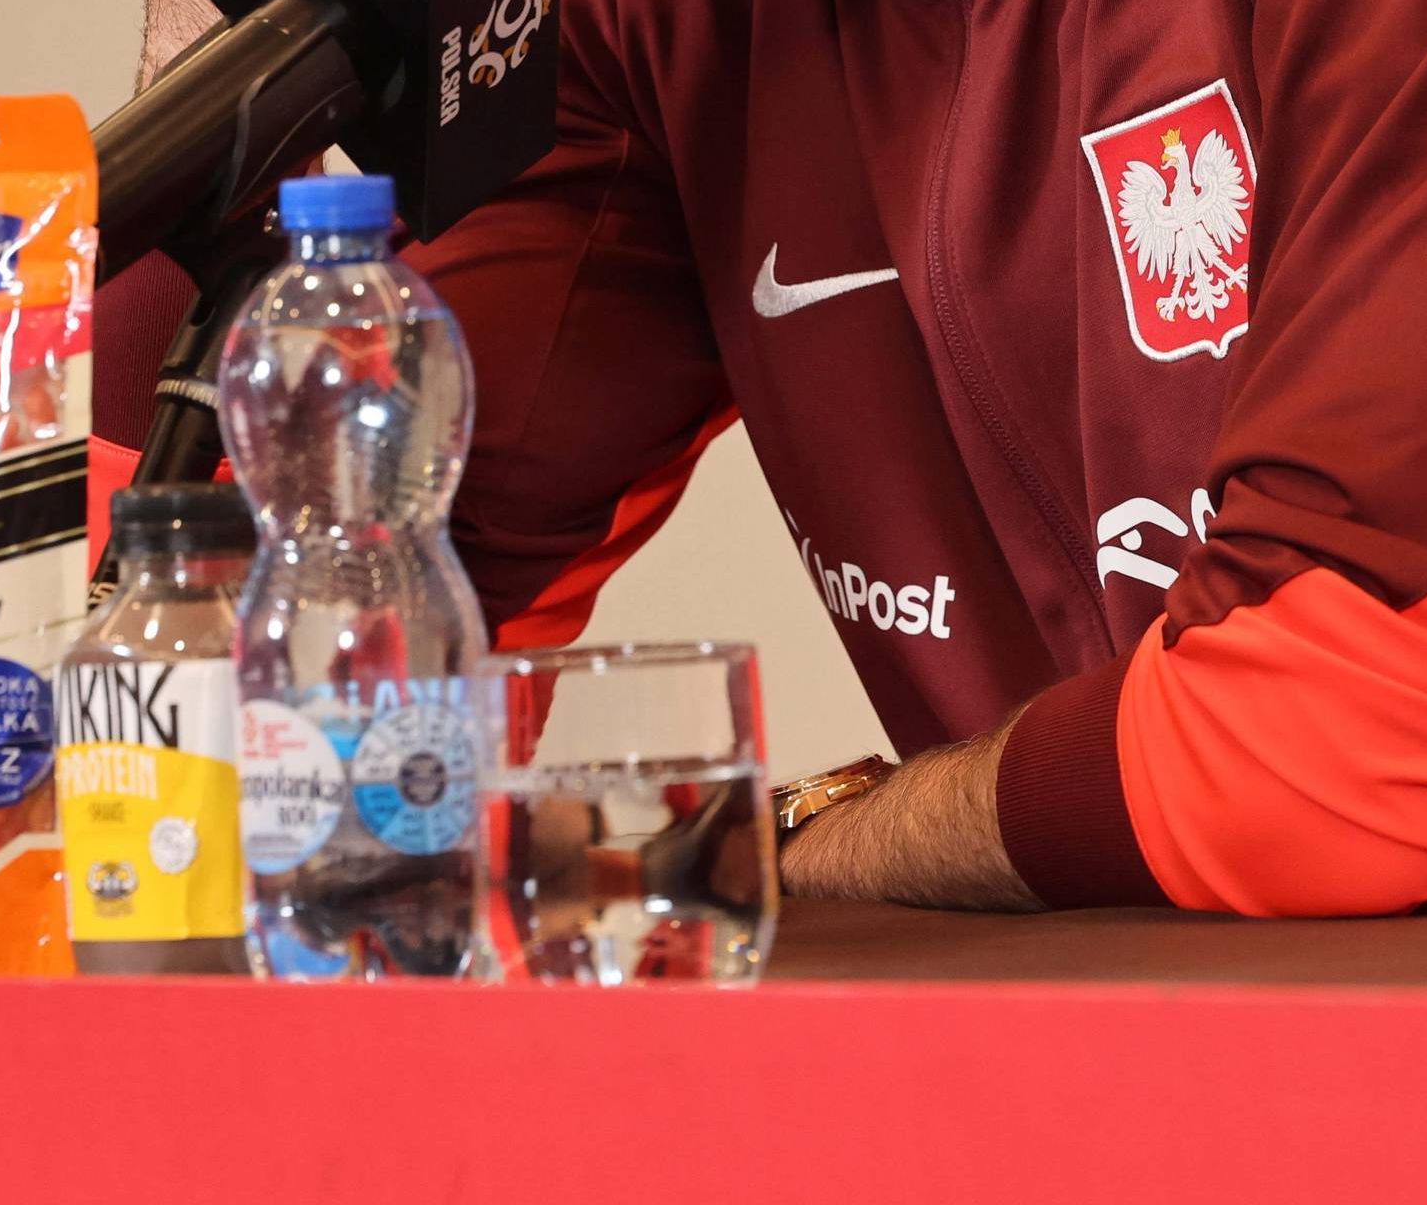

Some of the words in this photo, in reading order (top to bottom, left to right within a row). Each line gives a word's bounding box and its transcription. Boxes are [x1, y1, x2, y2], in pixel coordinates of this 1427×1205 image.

[440, 26, 462, 127] POLSKA
[814, 553, 956, 639] InPost
[58, 748, 160, 801] PROTEIN
